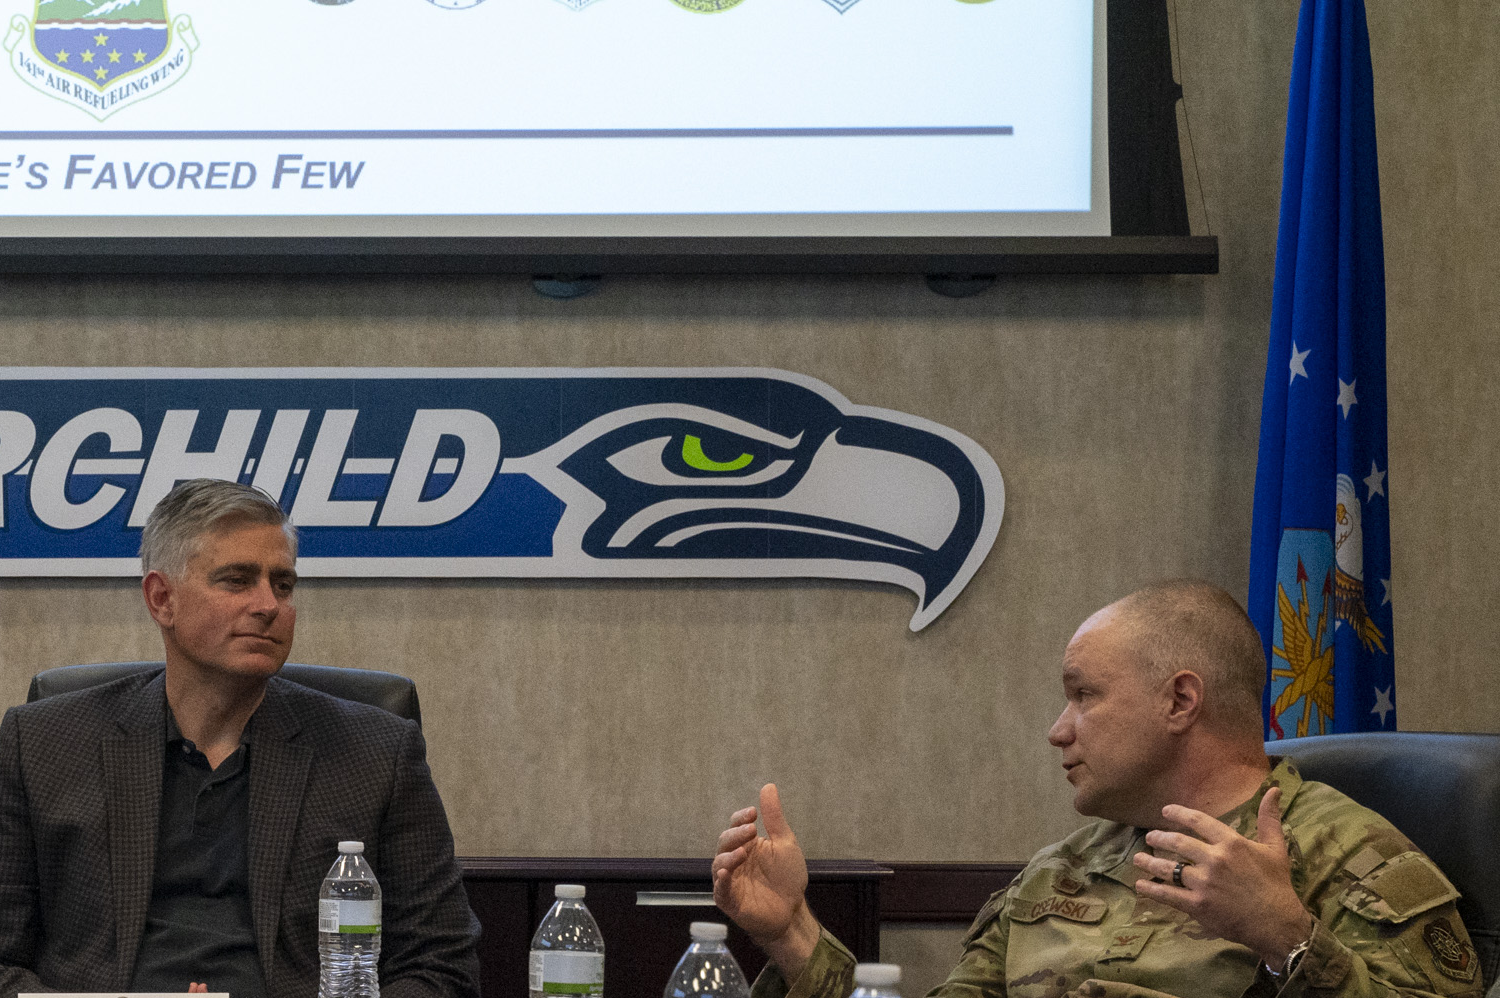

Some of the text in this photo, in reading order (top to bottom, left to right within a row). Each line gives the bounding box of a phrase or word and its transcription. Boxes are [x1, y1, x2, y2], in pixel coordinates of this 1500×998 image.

[46, 73, 70, 95] AIR
[73, 76, 149, 110] REFUELING
[150, 48, 184, 86] WING
[64, 154, 257, 190] FAVORED
[272, 154, 365, 189] FEW
